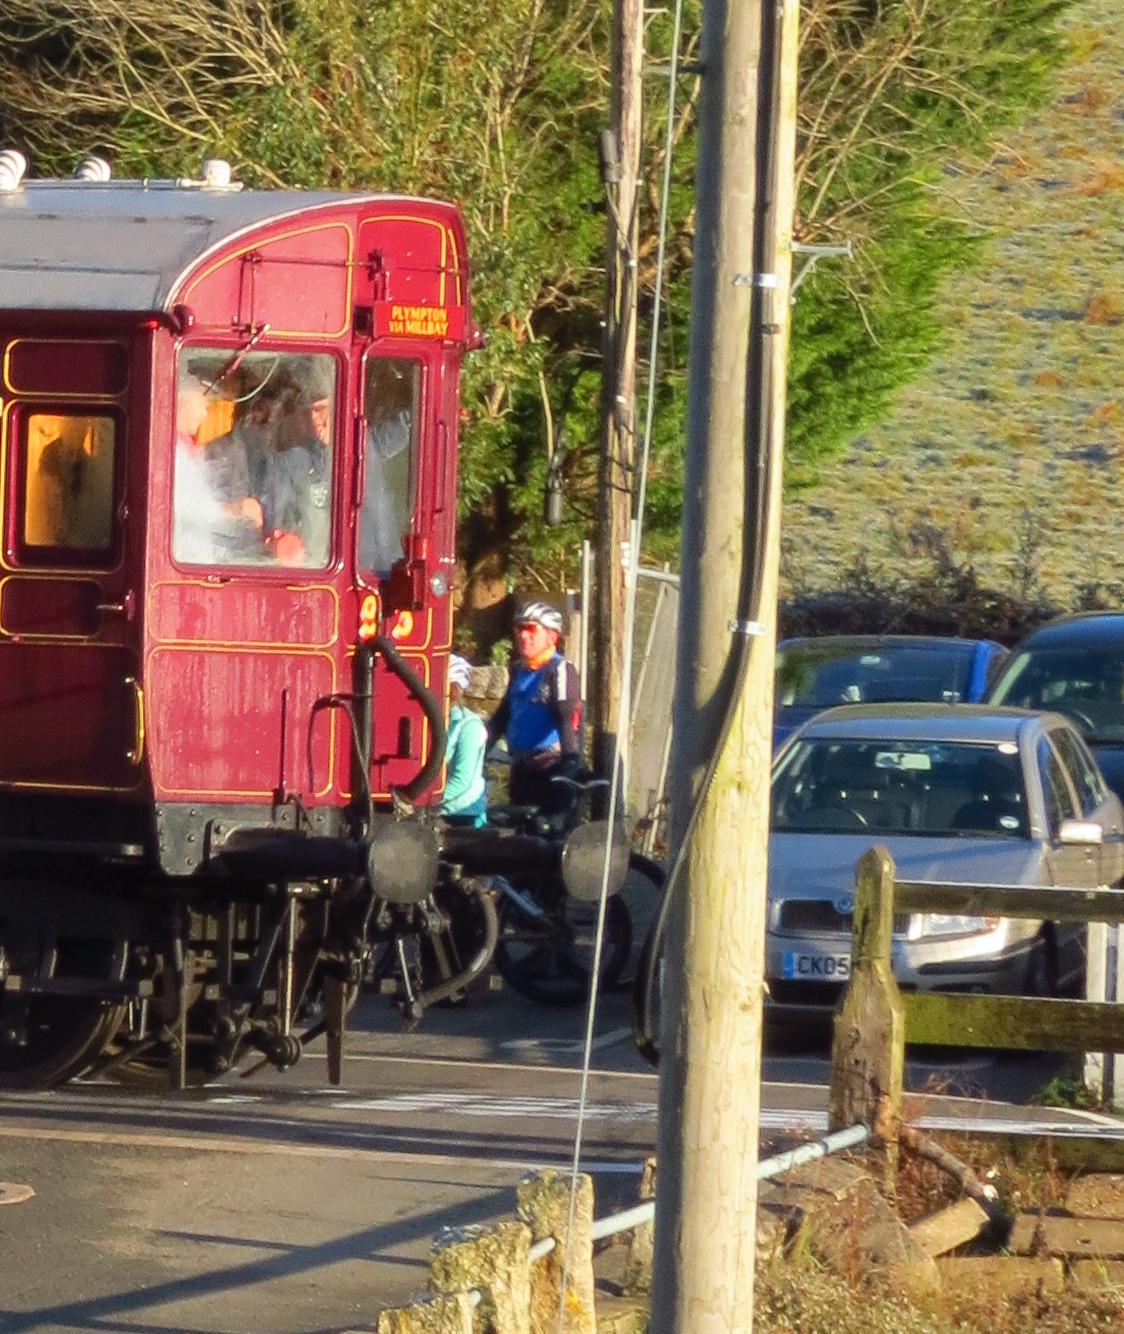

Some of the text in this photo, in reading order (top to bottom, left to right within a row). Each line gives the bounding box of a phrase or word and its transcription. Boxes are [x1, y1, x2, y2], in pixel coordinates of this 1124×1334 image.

[391, 304, 448, 322] PLYMPTON
[388, 320, 450, 336] VIA MILLBAY
